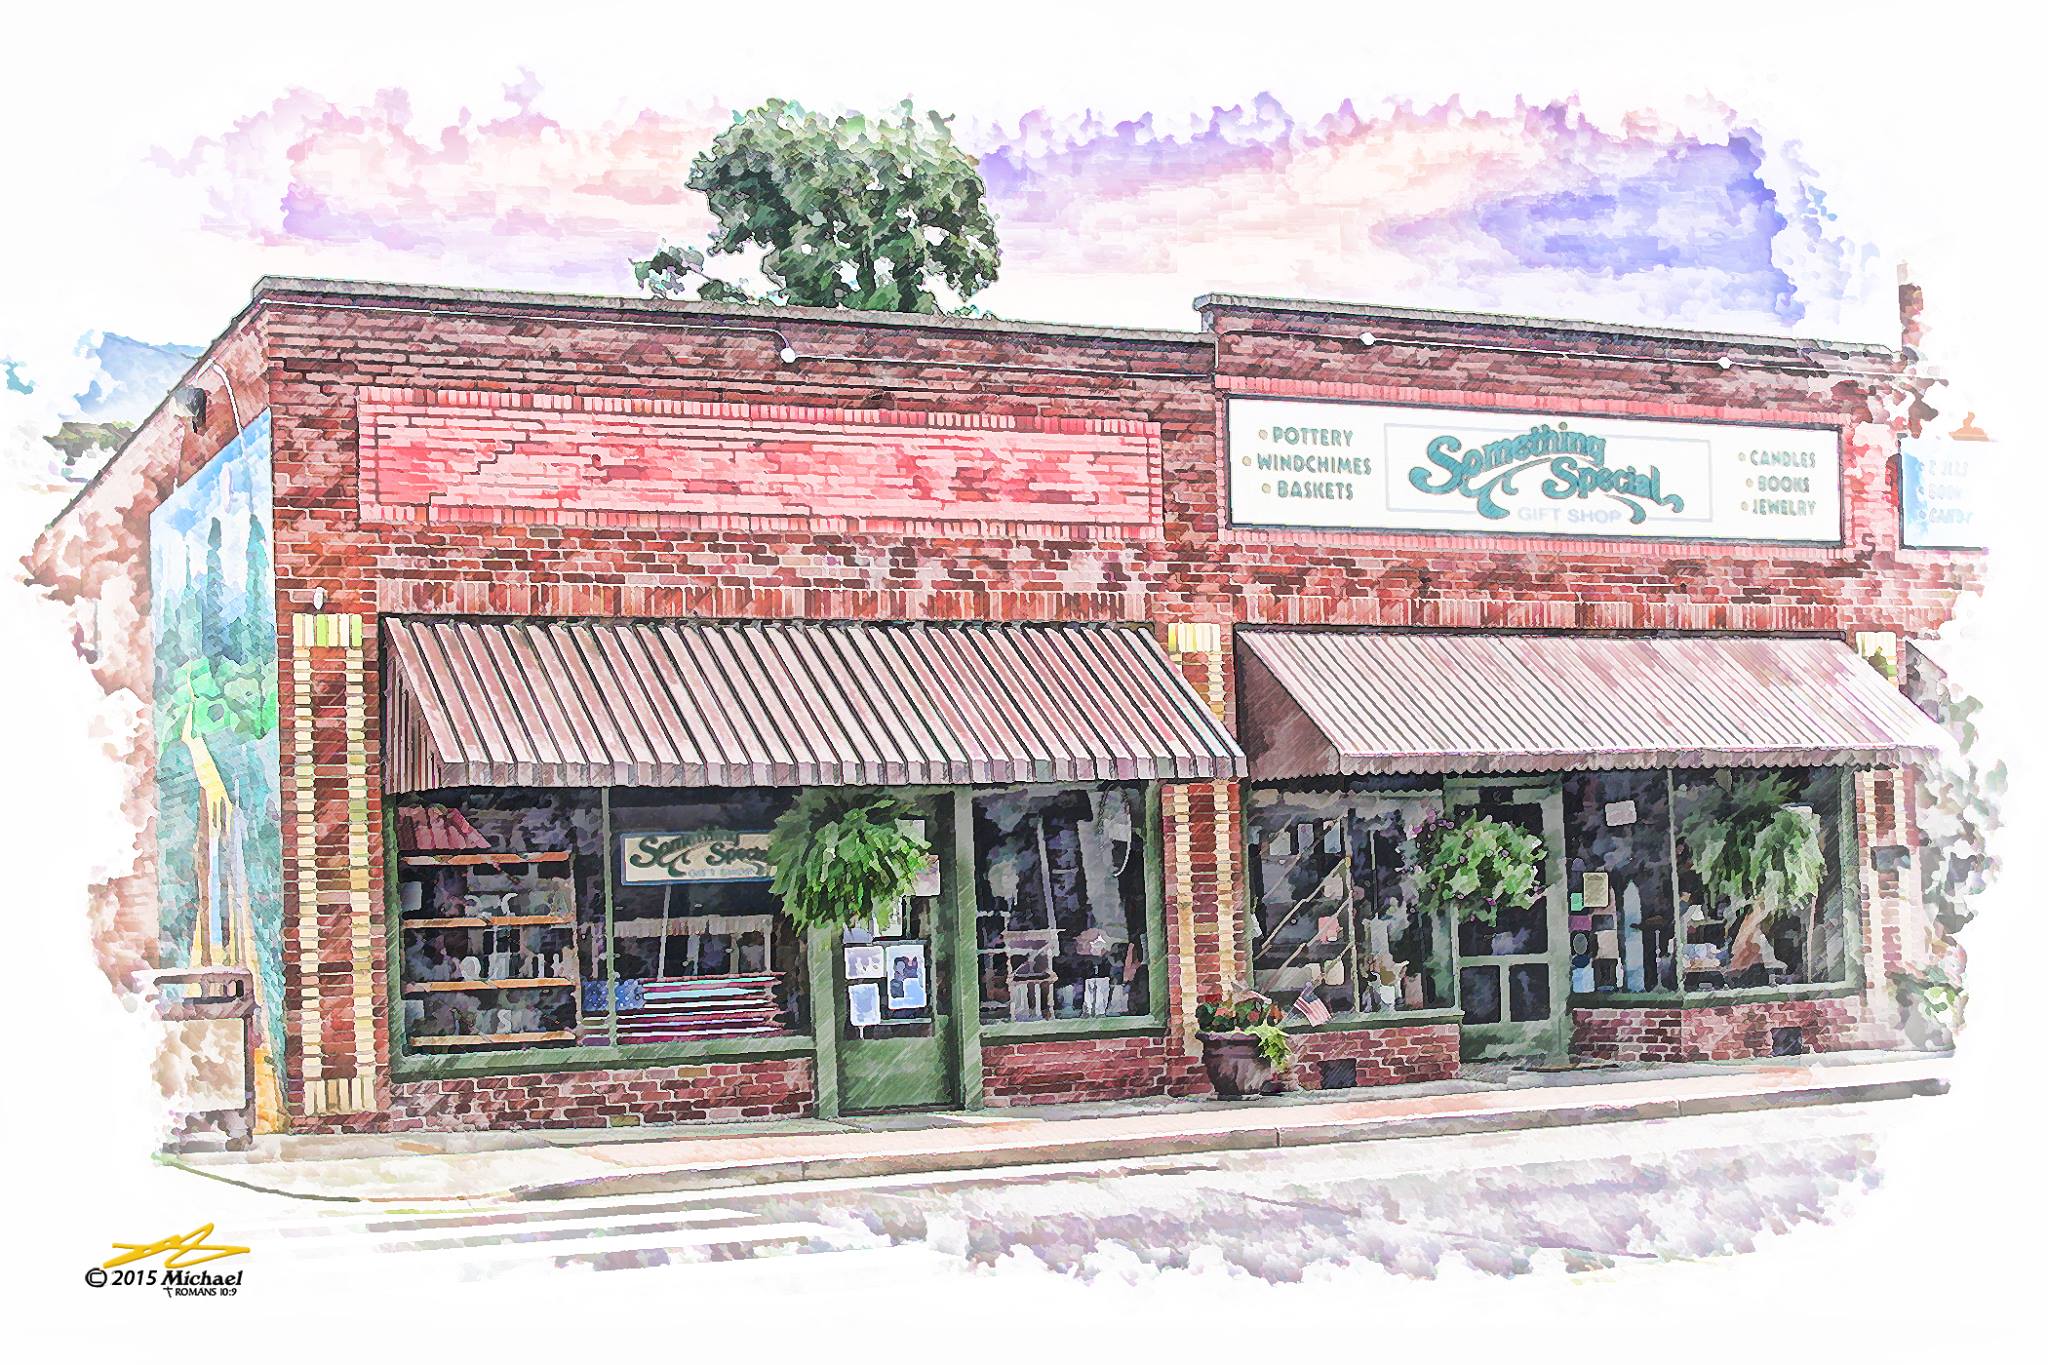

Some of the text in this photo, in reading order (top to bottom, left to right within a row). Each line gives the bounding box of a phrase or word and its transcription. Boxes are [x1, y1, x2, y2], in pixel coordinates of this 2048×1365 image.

[1272, 426, 1354, 447] POTTERY
[1257, 452, 1372, 476] WINDCHIMES
[1750, 449, 1816, 468] CANDLES
[1409, 421, 1606, 519] Something
[1277, 480, 1354, 501] BASKETS
[1542, 456, 1684, 514] Special
[1758, 475, 1810, 493] BOOKS
[1517, 506, 1622, 525] GIFT SHOP
[1752, 498, 1817, 516] JEWELRY
